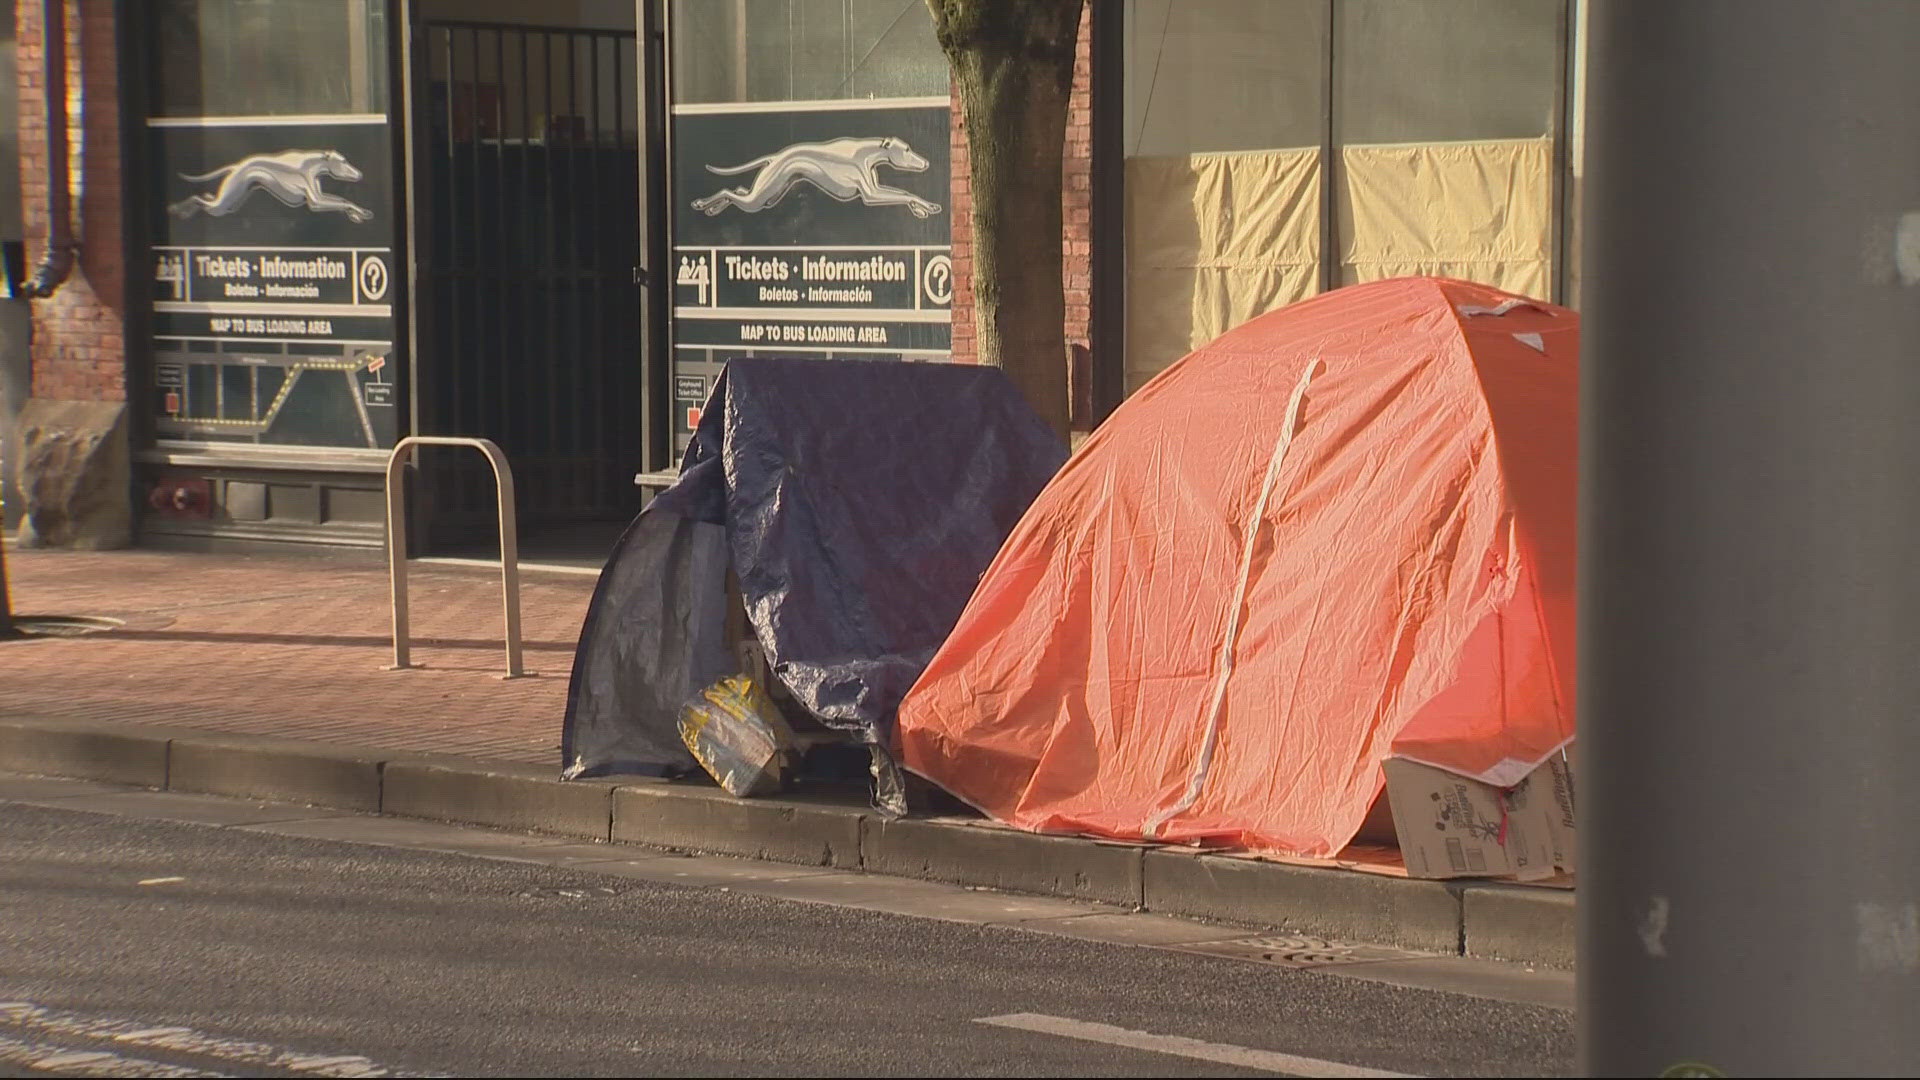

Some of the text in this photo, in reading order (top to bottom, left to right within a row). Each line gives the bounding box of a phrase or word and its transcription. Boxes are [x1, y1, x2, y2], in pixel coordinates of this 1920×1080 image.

[196, 255, 346, 279] Tickets Information
[725, 255, 906, 282] Tickets Information
[224, 283, 320, 298] Boletos Información
[759, 286, 873, 303] Boletos Información
[210, 319, 333, 335] MAP TO BUS LOADING AREA
[741, 324, 888, 343] MAP TO BUS LOADING AREA
[678, 380, 702, 388] Greyhound
[678, 388, 690, 396] Ticket
